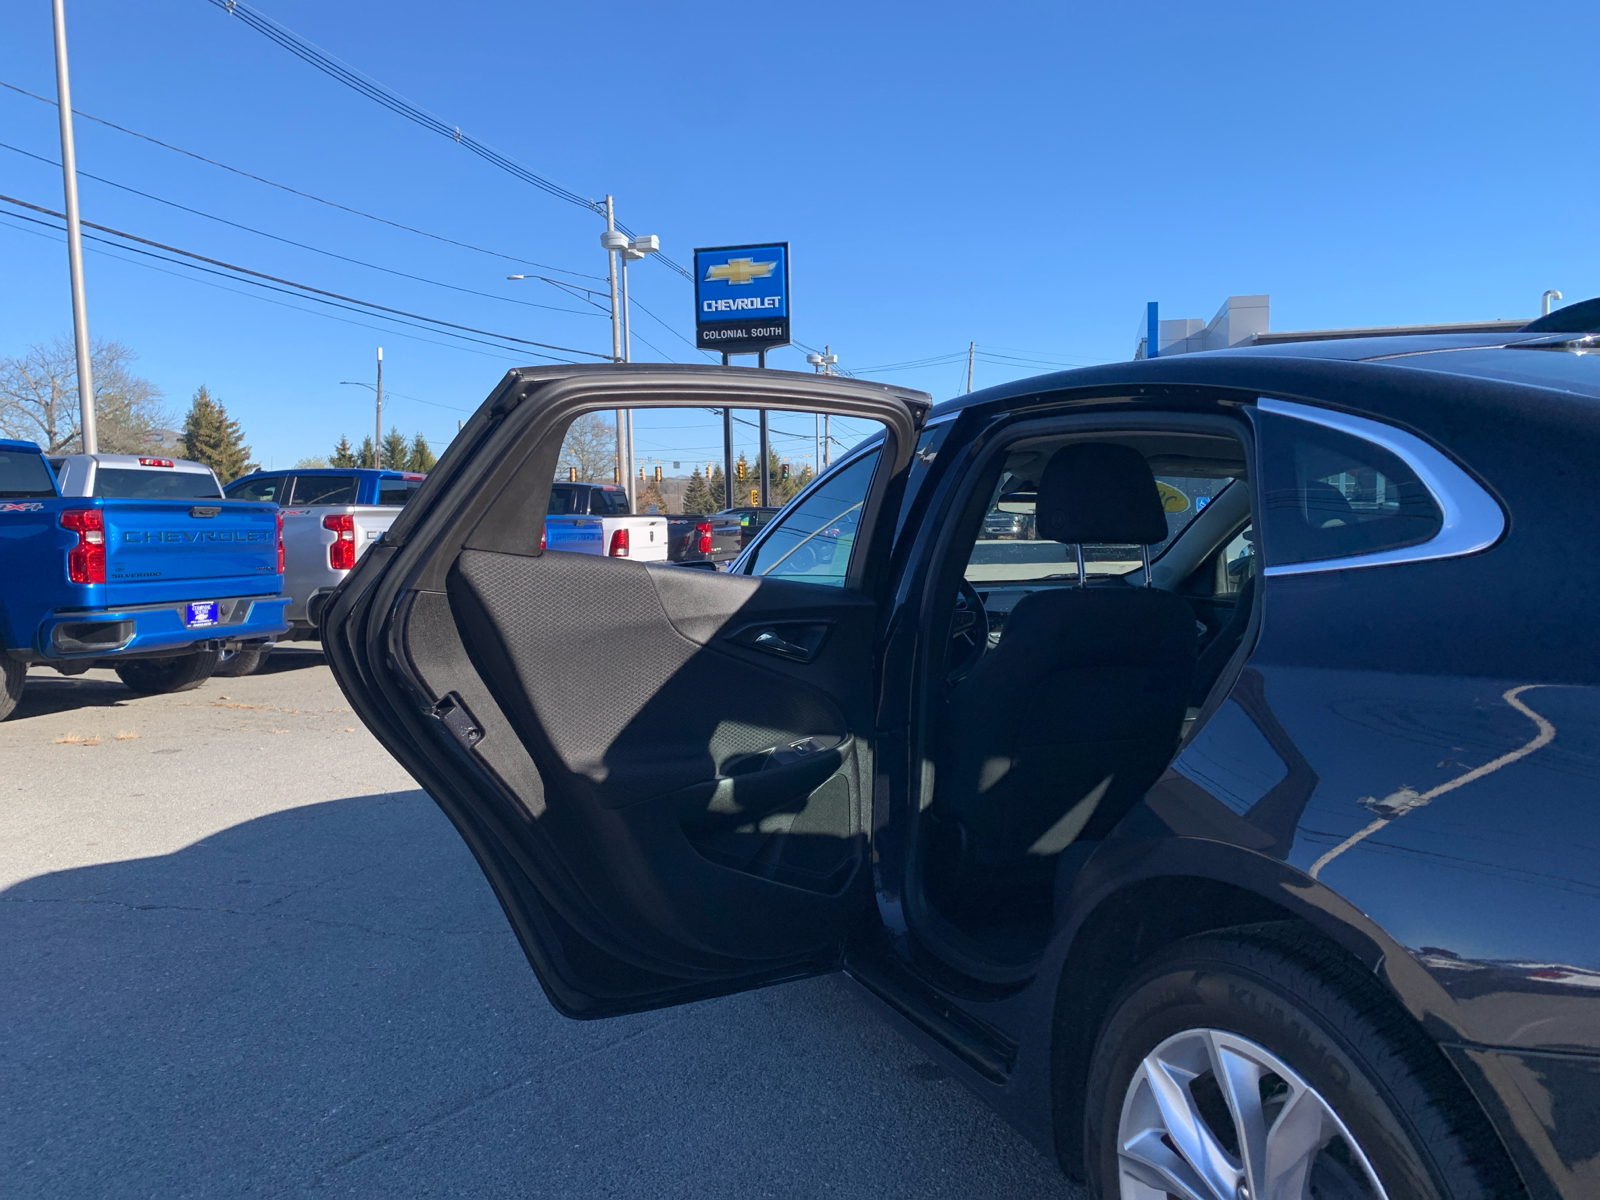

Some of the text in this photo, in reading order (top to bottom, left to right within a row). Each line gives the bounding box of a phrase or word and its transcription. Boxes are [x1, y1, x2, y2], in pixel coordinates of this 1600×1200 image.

[703, 296, 781, 312] CHEVROLET
[703, 327, 782, 340] COLONIAL SOUTH
[123, 530, 273, 544] CHEVROLET
